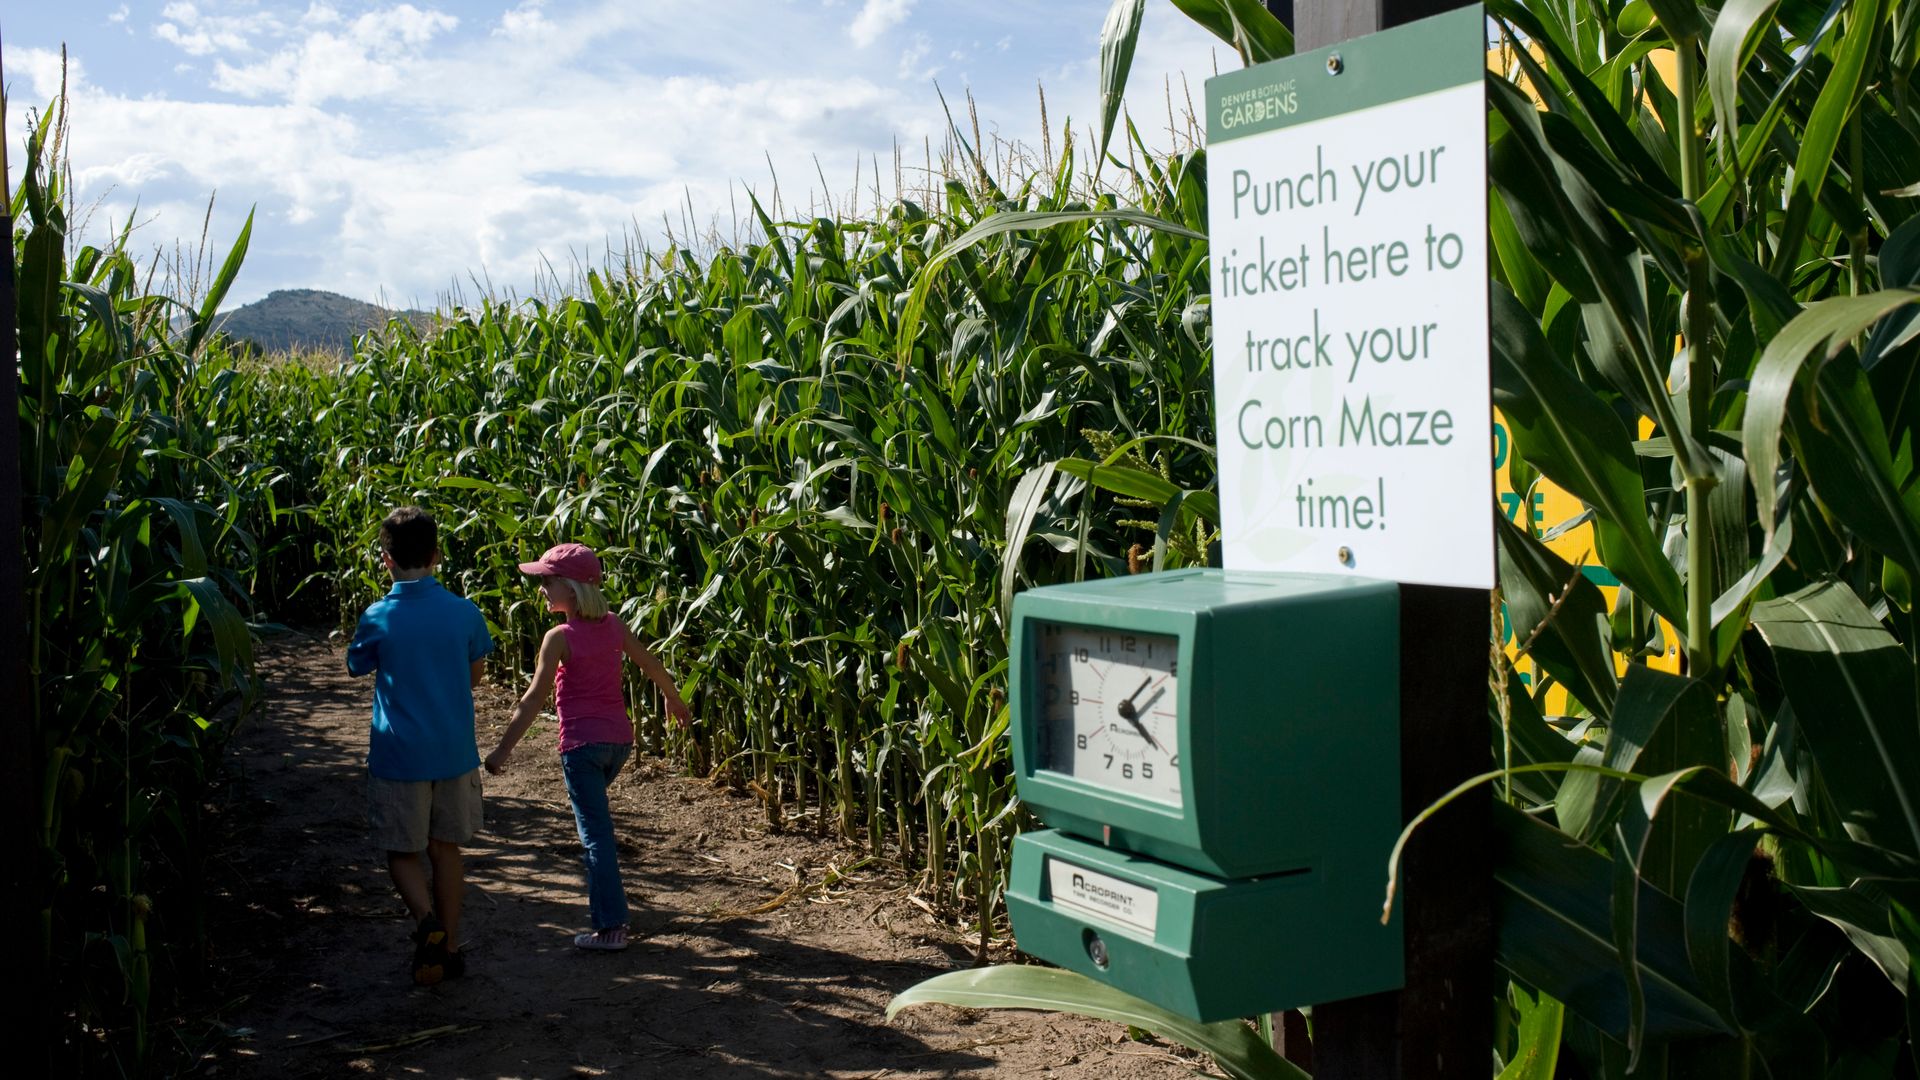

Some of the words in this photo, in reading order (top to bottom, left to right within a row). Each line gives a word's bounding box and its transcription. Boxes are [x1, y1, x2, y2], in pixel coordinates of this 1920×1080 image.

[1221, 89, 1257, 108] DENVER
[1258, 79, 1296, 98] BOTANIC
[1221, 92, 1298, 129] GARDENS
[1233, 145, 1337, 219] Punch
[1352, 146, 1445, 216] your
[1221, 236, 1310, 298] ticket
[1324, 225, 1409, 285] here
[1425, 224, 1464, 272] to
[1246, 308, 1333, 373] track
[1345, 323, 1437, 383] your
[1238, 399, 1323, 450] Corn
[1339, 392, 1454, 447] Maze
[1296, 477, 1386, 531] time!
[1100, 637, 1111, 653] 11
[1120, 636, 1136, 652] 12
[1074, 647, 1089, 663] 10
[1070, 691, 1080, 705] 9
[1077, 734, 1087, 750] 8
[1103, 754, 1114, 770] 7
[1142, 762, 1153, 779] 5
[1122, 763, 1133, 779] 6
